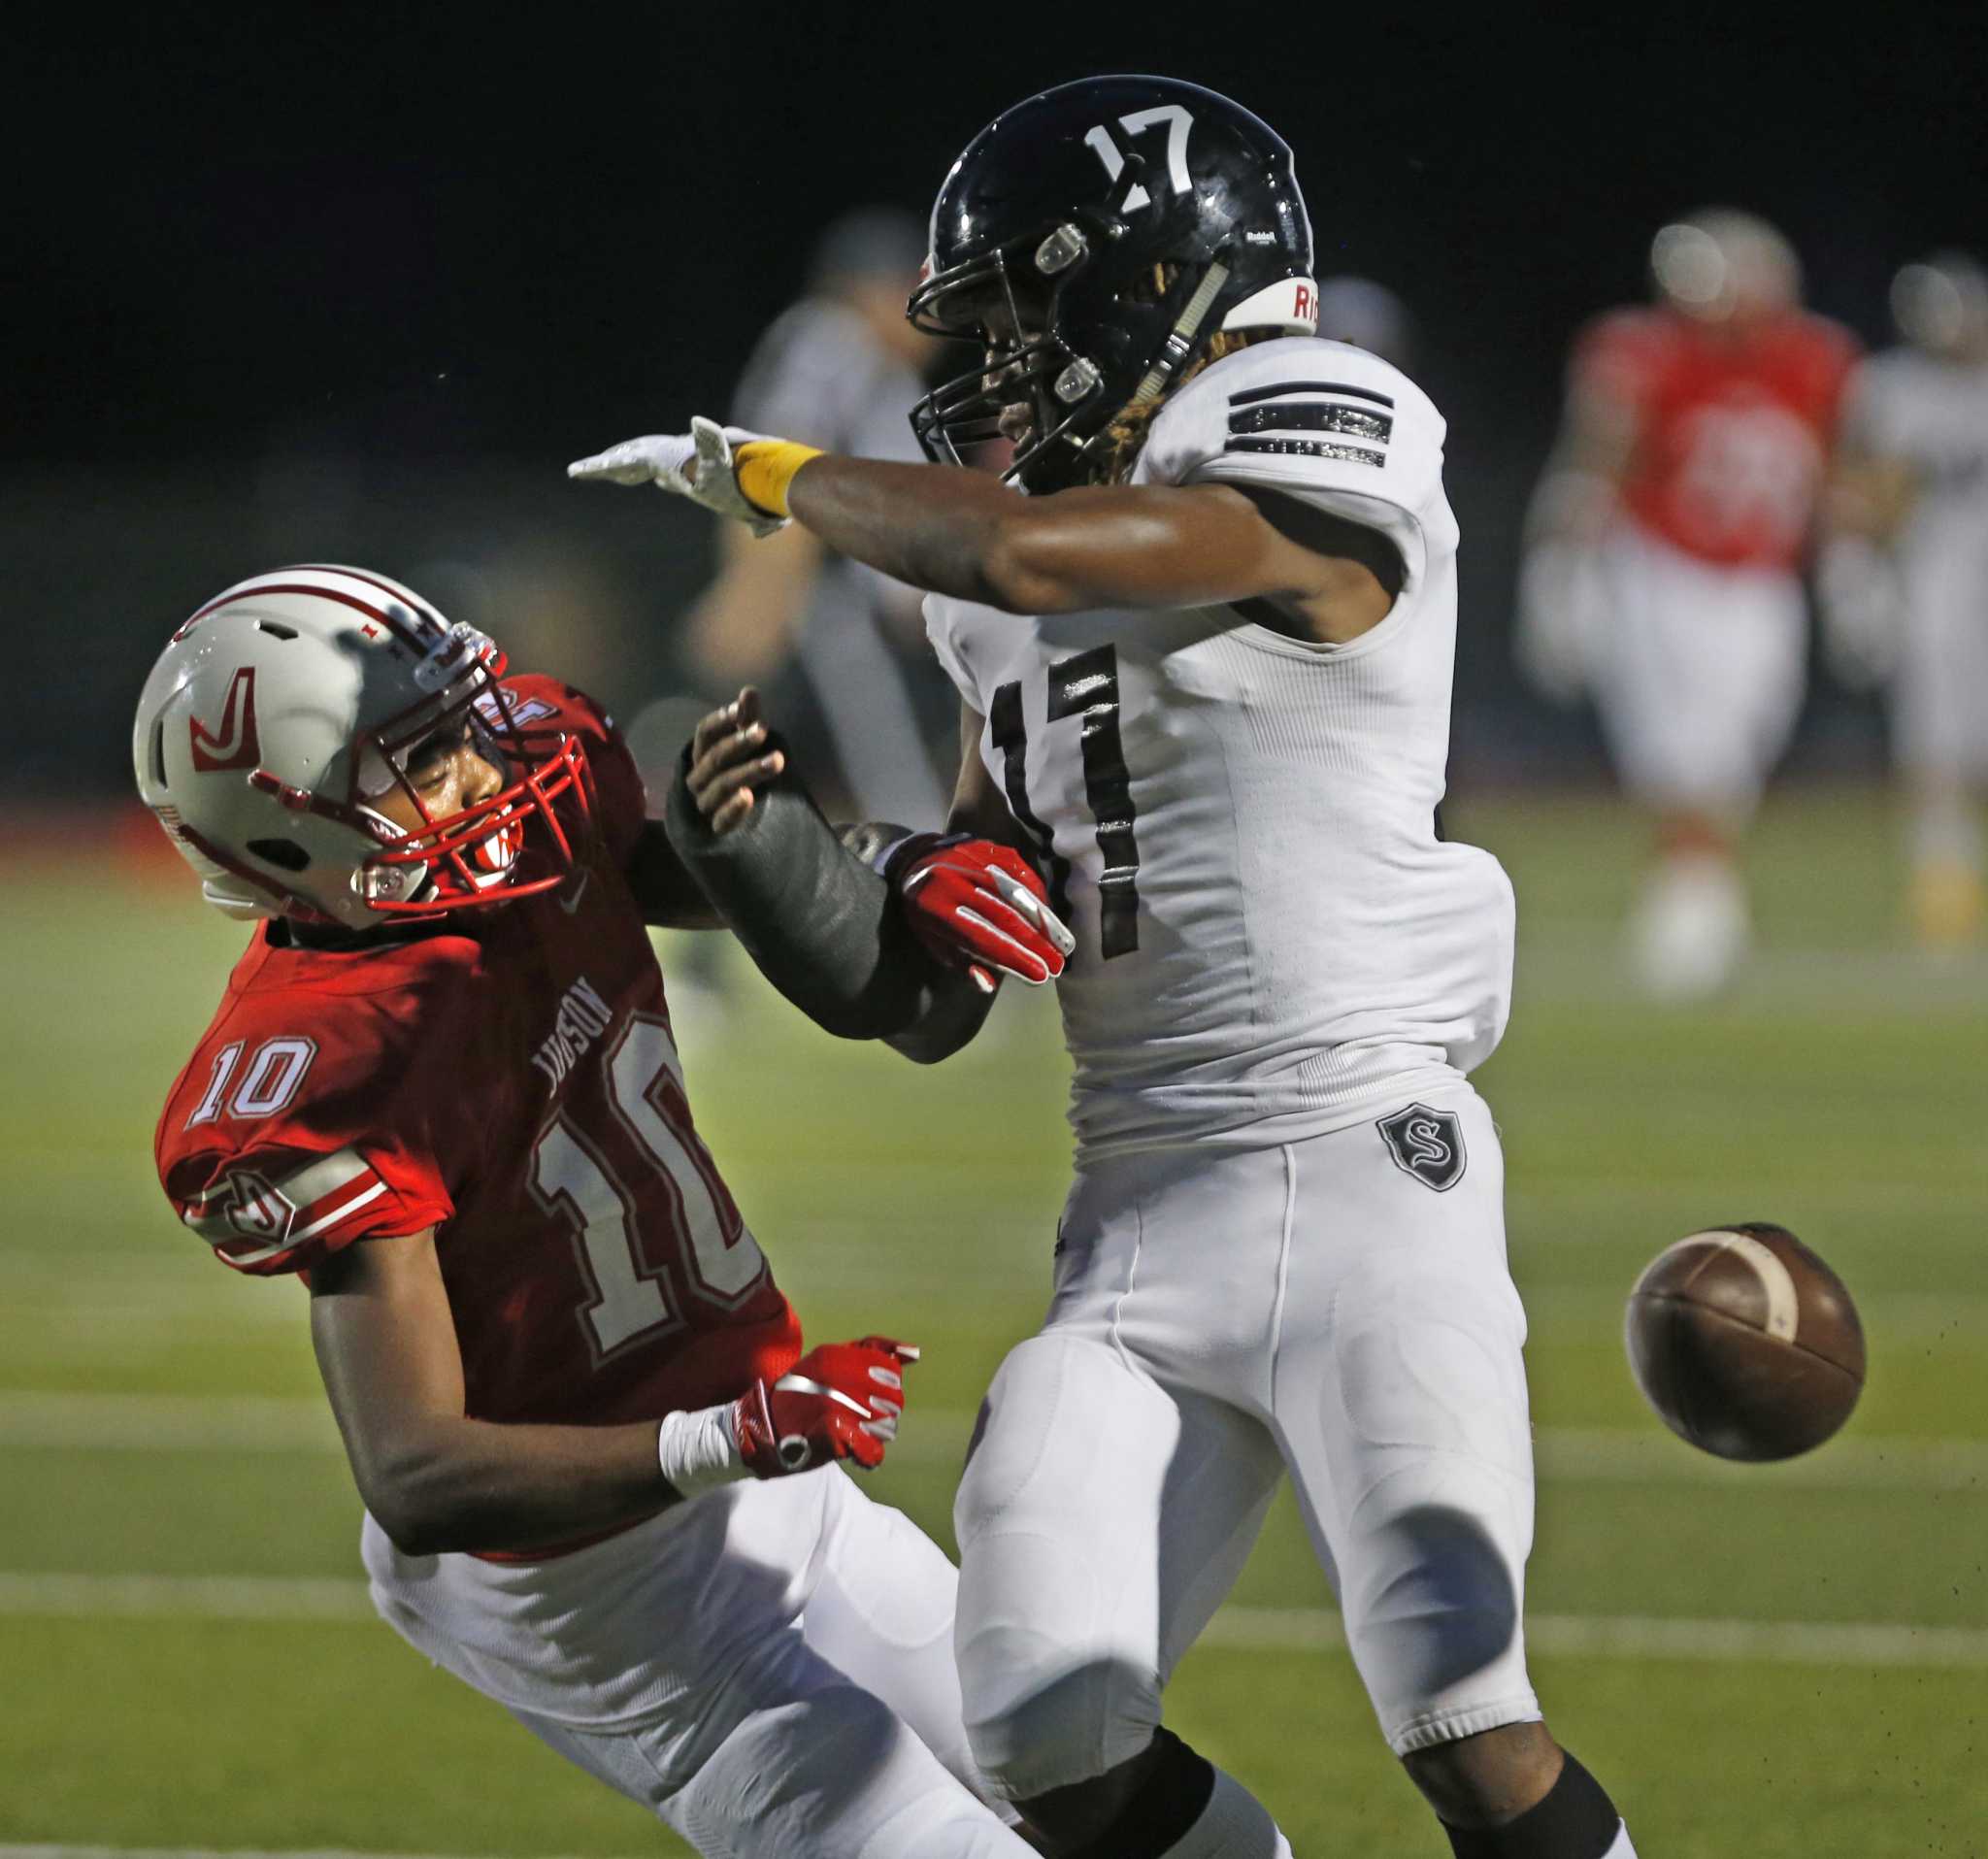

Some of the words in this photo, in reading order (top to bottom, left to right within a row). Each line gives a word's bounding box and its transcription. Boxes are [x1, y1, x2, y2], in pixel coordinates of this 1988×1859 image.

[1084, 104, 1195, 214] 17
[990, 642, 1141, 969] 17
[183, 1035, 318, 1132] 10
[526, 1009, 771, 1371] 10
